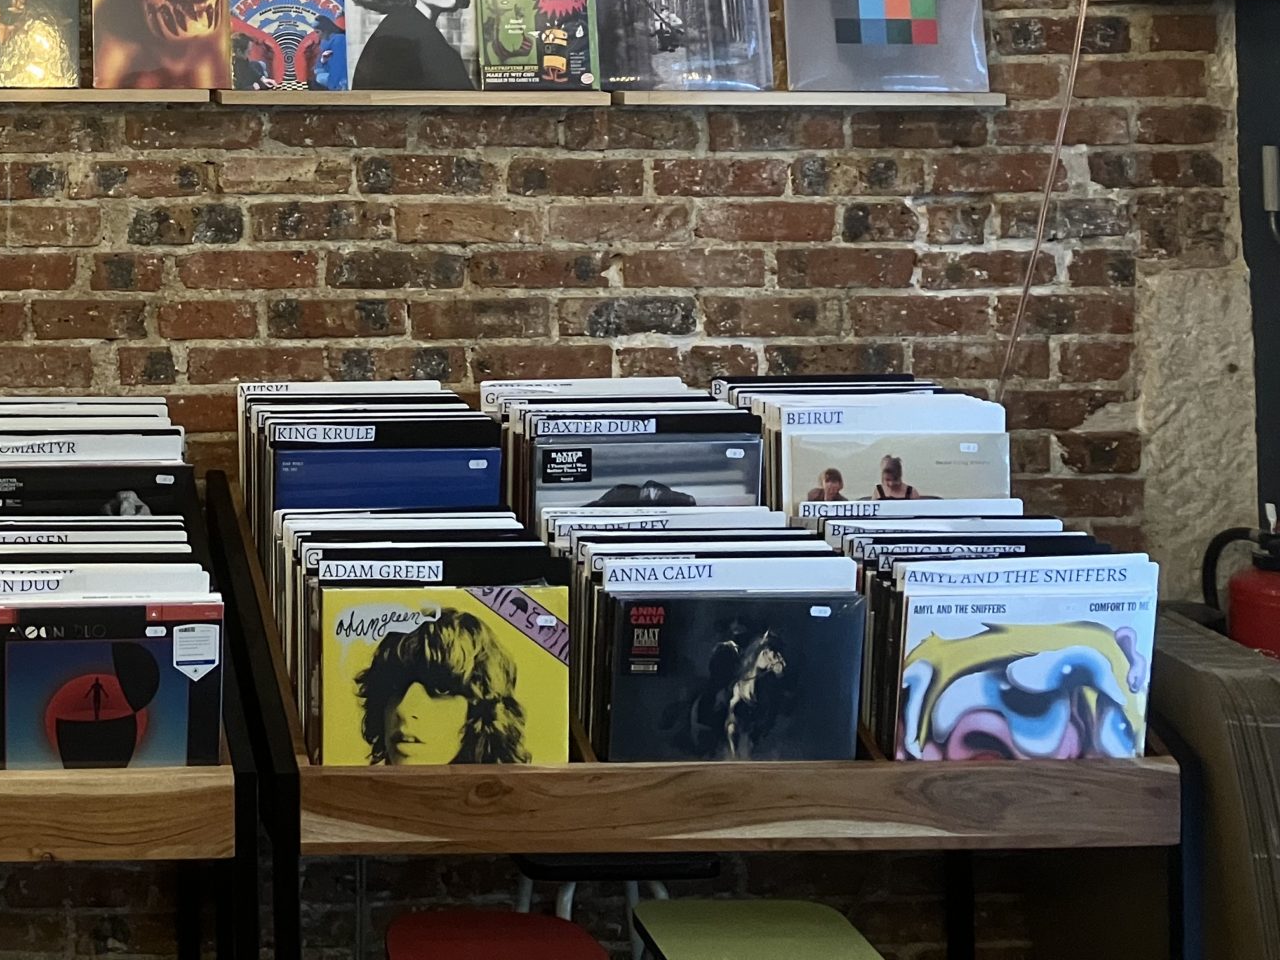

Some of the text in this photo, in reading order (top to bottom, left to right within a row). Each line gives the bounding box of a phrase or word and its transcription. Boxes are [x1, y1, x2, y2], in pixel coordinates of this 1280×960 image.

[787, 411, 844, 425] BEIRUT
[541, 419, 651, 433] BAXTER DURY
[277, 427, 374, 440] KING KRULE
[802, 505, 828, 516] BIG
[322, 565, 440, 579] ADAM GREEN
[608, 565, 713, 582] ANNA CALVI
[908, 569, 1128, 583] AMYL AND THE SNIFFERS
[20, 579, 60, 591] DUO
[914, 604, 1006, 615] AMYL AND THE SNIFFERS
[1089, 602, 1124, 612] COMFORT
[1127, 602, 1137, 611] TO
